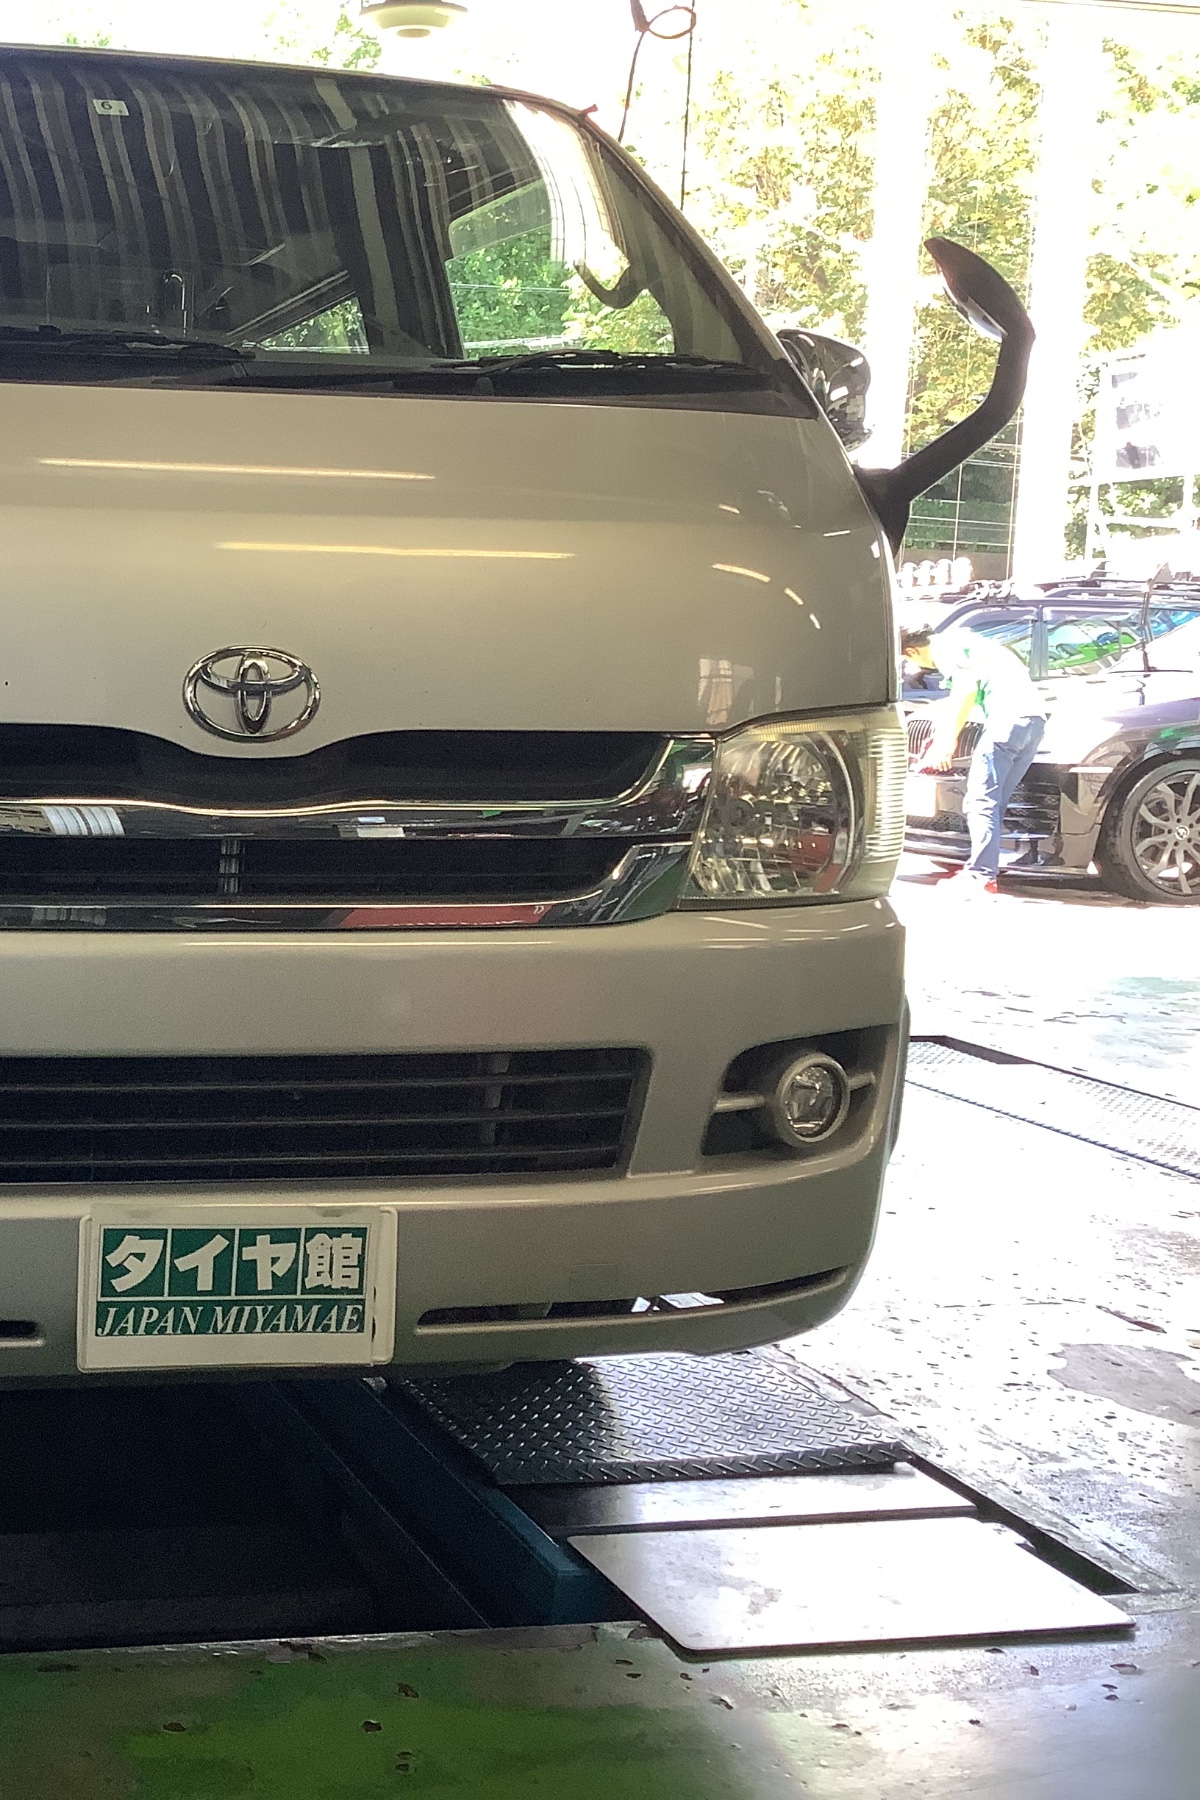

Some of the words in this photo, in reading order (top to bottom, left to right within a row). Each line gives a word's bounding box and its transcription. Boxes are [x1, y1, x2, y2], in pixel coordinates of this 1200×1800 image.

[104, 1233, 363, 1293] タイヤ館
[97, 1306, 205, 1336] JAPAN
[208, 1304, 363, 1334] MIYAMAE
